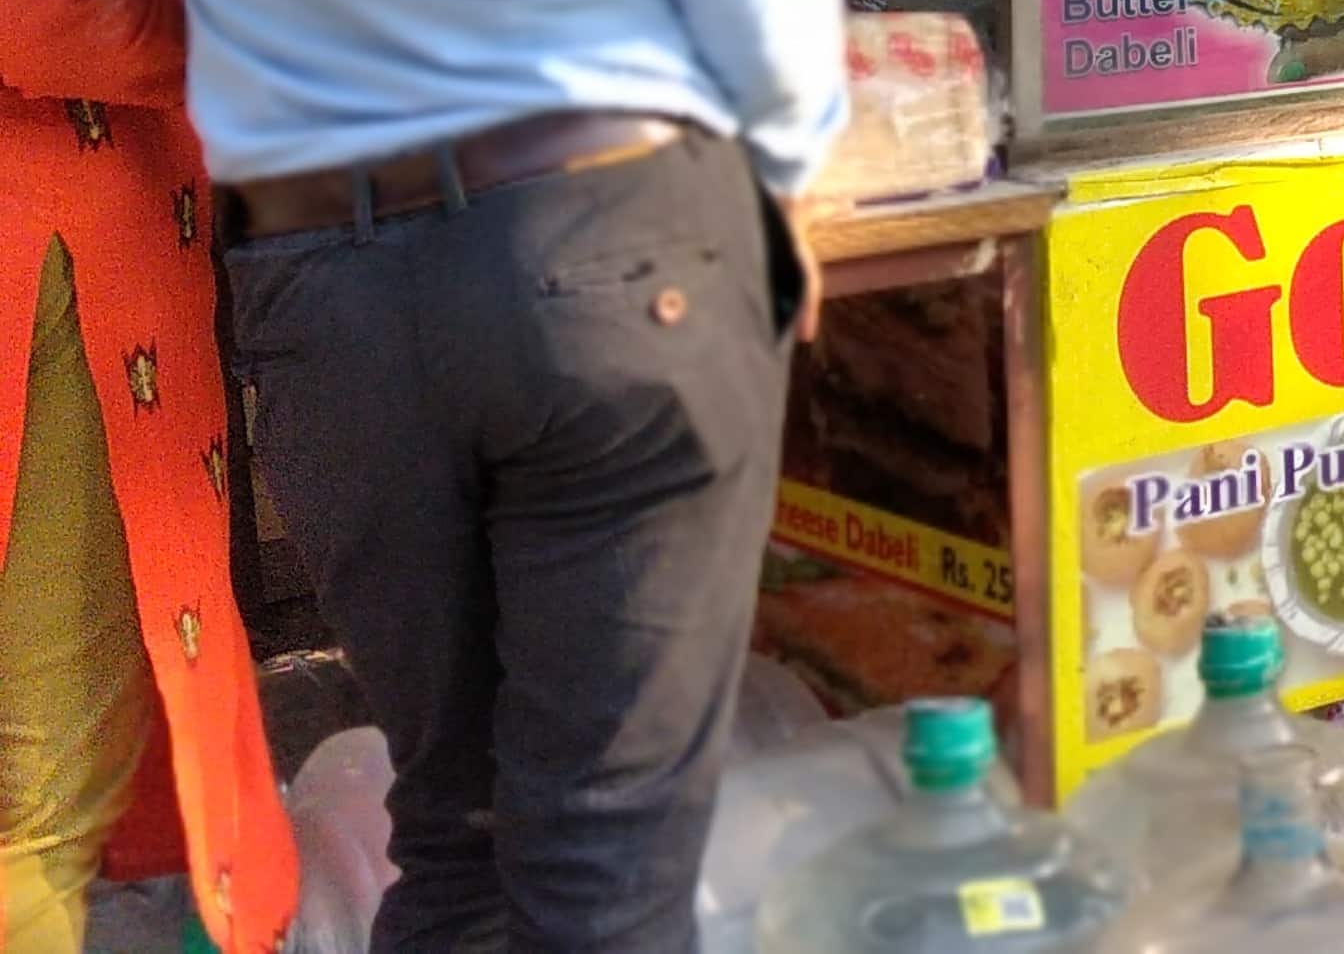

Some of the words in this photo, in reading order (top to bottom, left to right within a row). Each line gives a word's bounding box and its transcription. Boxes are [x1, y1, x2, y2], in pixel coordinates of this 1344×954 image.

[1064, 28, 1197, 78] Dabeli
[1132, 454, 1262, 529] Pani
[846, 512, 918, 569] Dabeli
[942, 546, 976, 591] Rs.
[984, 559, 1014, 604] 25
